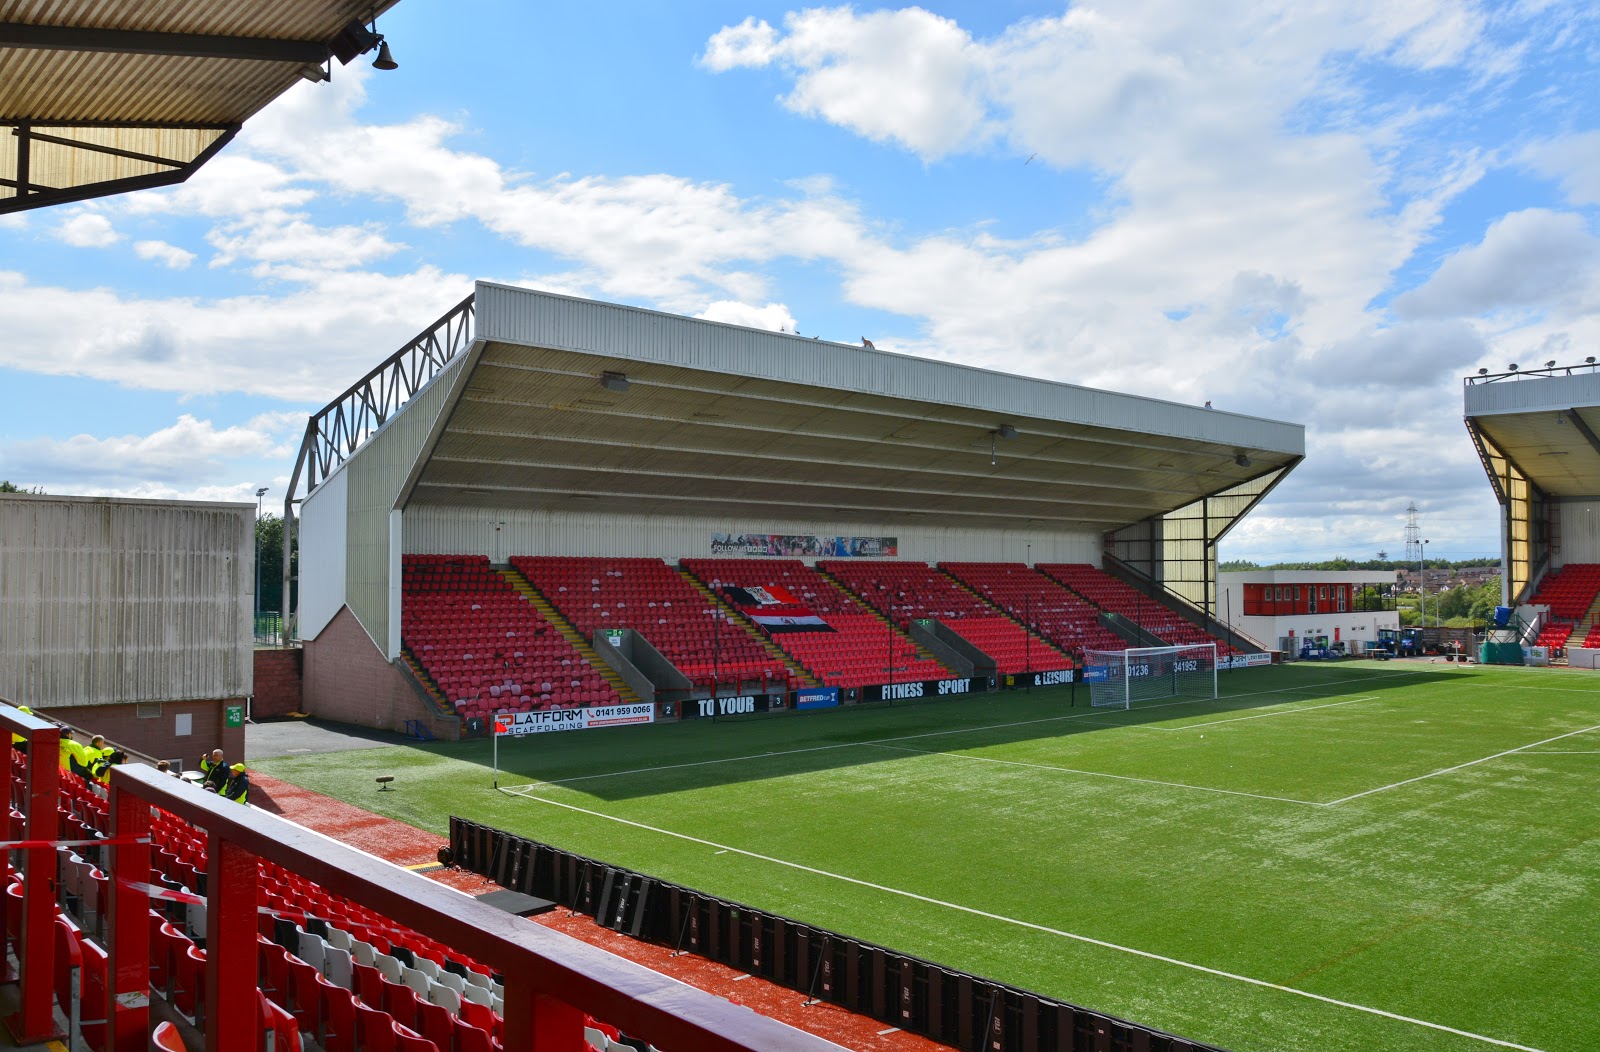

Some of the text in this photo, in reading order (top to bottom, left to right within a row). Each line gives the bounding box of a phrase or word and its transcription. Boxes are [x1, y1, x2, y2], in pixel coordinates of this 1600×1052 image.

[1127, 665, 1149, 677] 01236
[1034, 674, 1042, 686] &
[881, 682, 924, 700] FITNESS
[938, 678, 971, 695] SPORT
[799, 694, 824, 703] BETFRED
[849, 690, 855, 698] 4
[698, 696, 755, 717] TO YOUR
[776, 697, 781, 705] 3
[595, 708, 615, 717] 0141
[616, 707, 631, 715] 959
[665, 706, 671, 714] 2
[497, 709, 582, 726] PLATFORM
[508, 722, 583, 735] SCAFFOLDING
